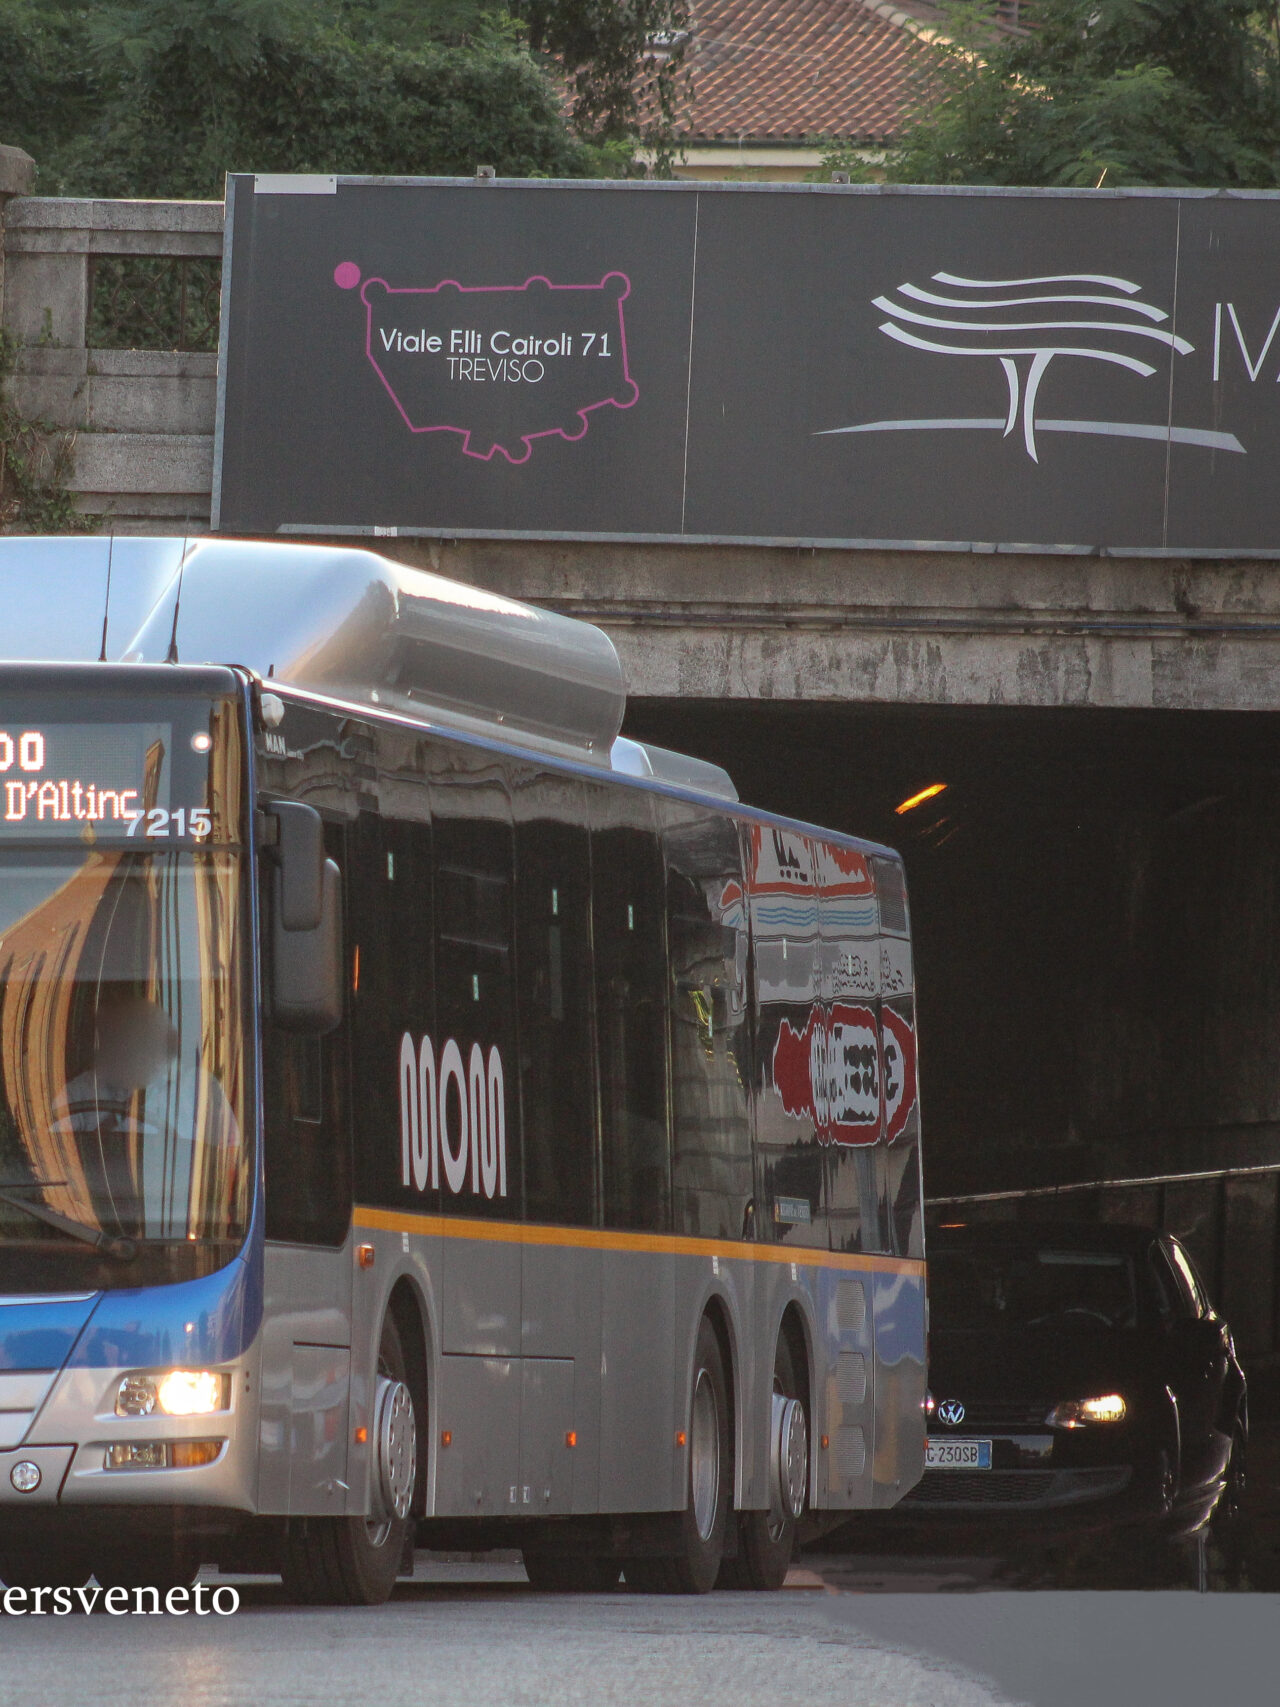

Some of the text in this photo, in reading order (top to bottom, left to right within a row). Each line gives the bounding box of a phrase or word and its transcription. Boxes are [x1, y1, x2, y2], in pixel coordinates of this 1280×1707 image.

[380, 328, 612, 357] Viale F.lli Cairoli 71
[1213, 303, 1280, 382] IV
[446, 357, 545, 383] TREVISO
[124, 808, 212, 838] 7215
[400, 1031, 507, 1199] MOM
